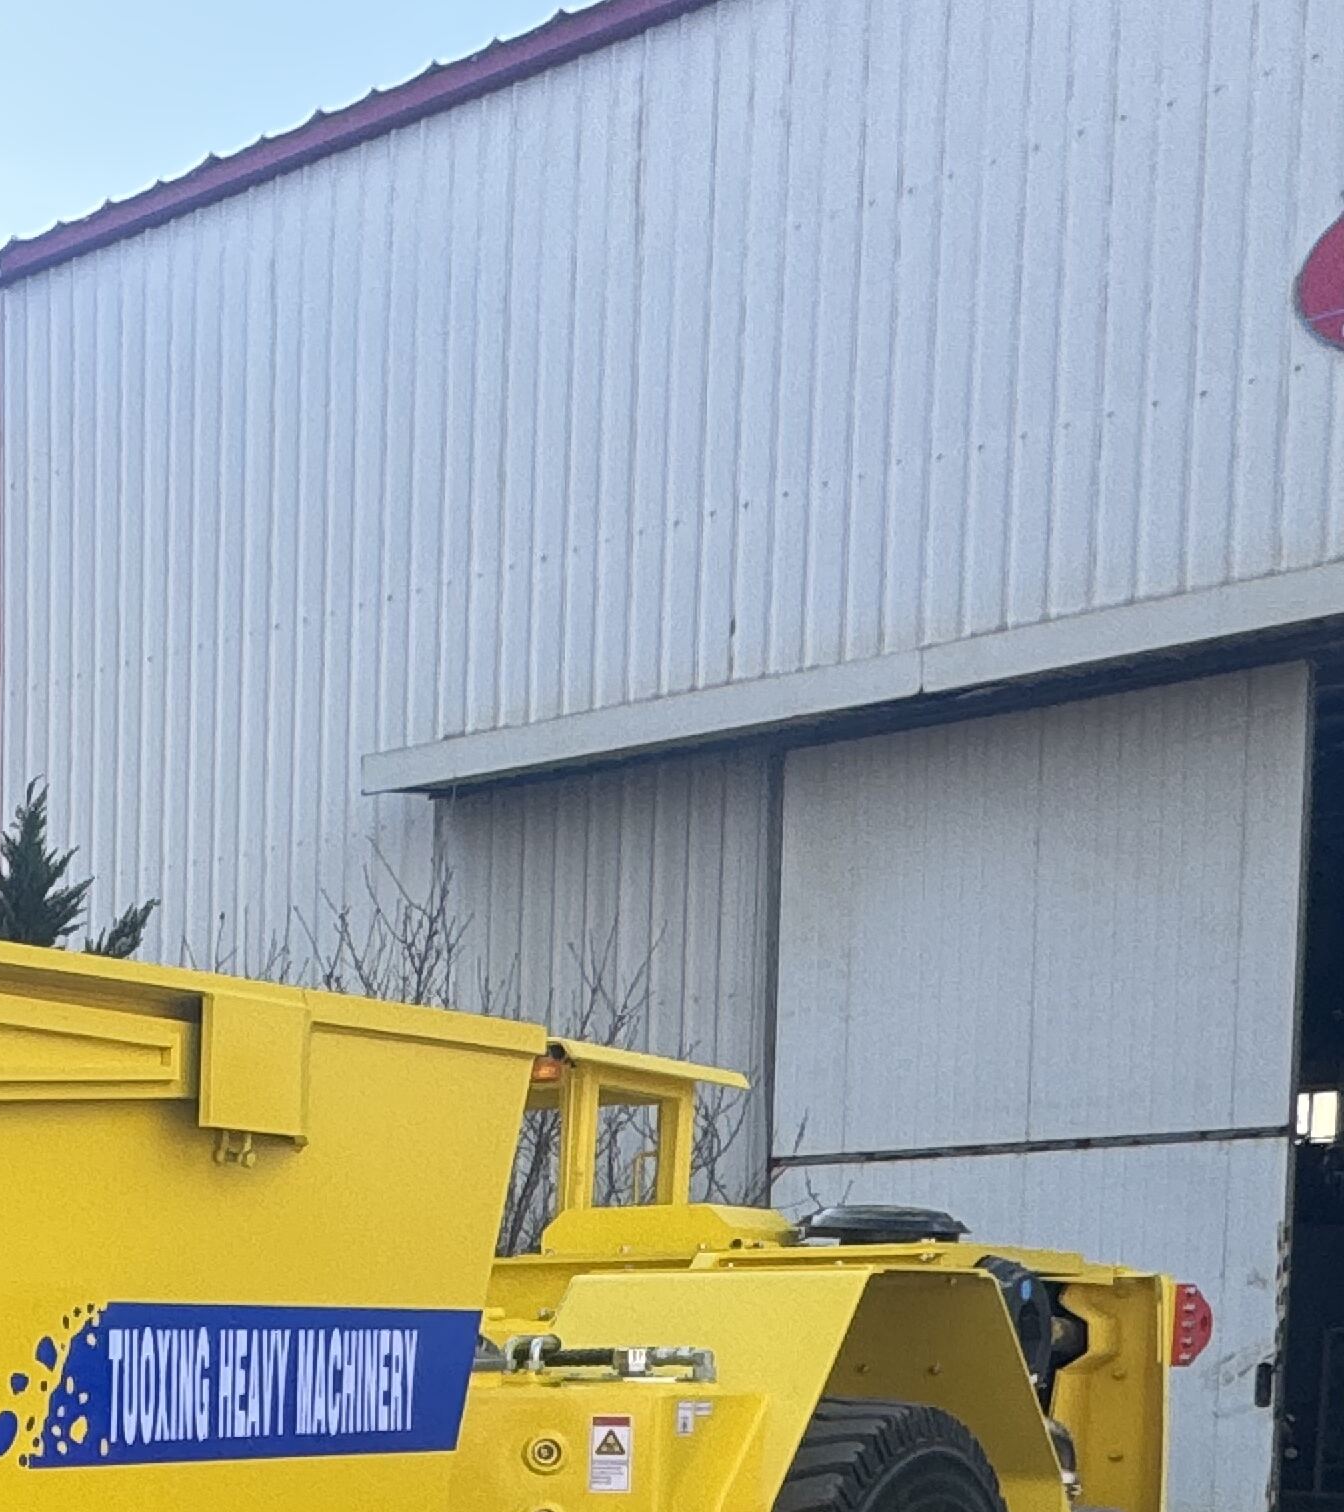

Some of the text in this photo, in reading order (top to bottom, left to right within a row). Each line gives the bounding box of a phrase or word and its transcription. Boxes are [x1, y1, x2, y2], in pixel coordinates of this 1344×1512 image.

[109, 1326, 418, 1445] TUOXING HEAVY MACHINERY
